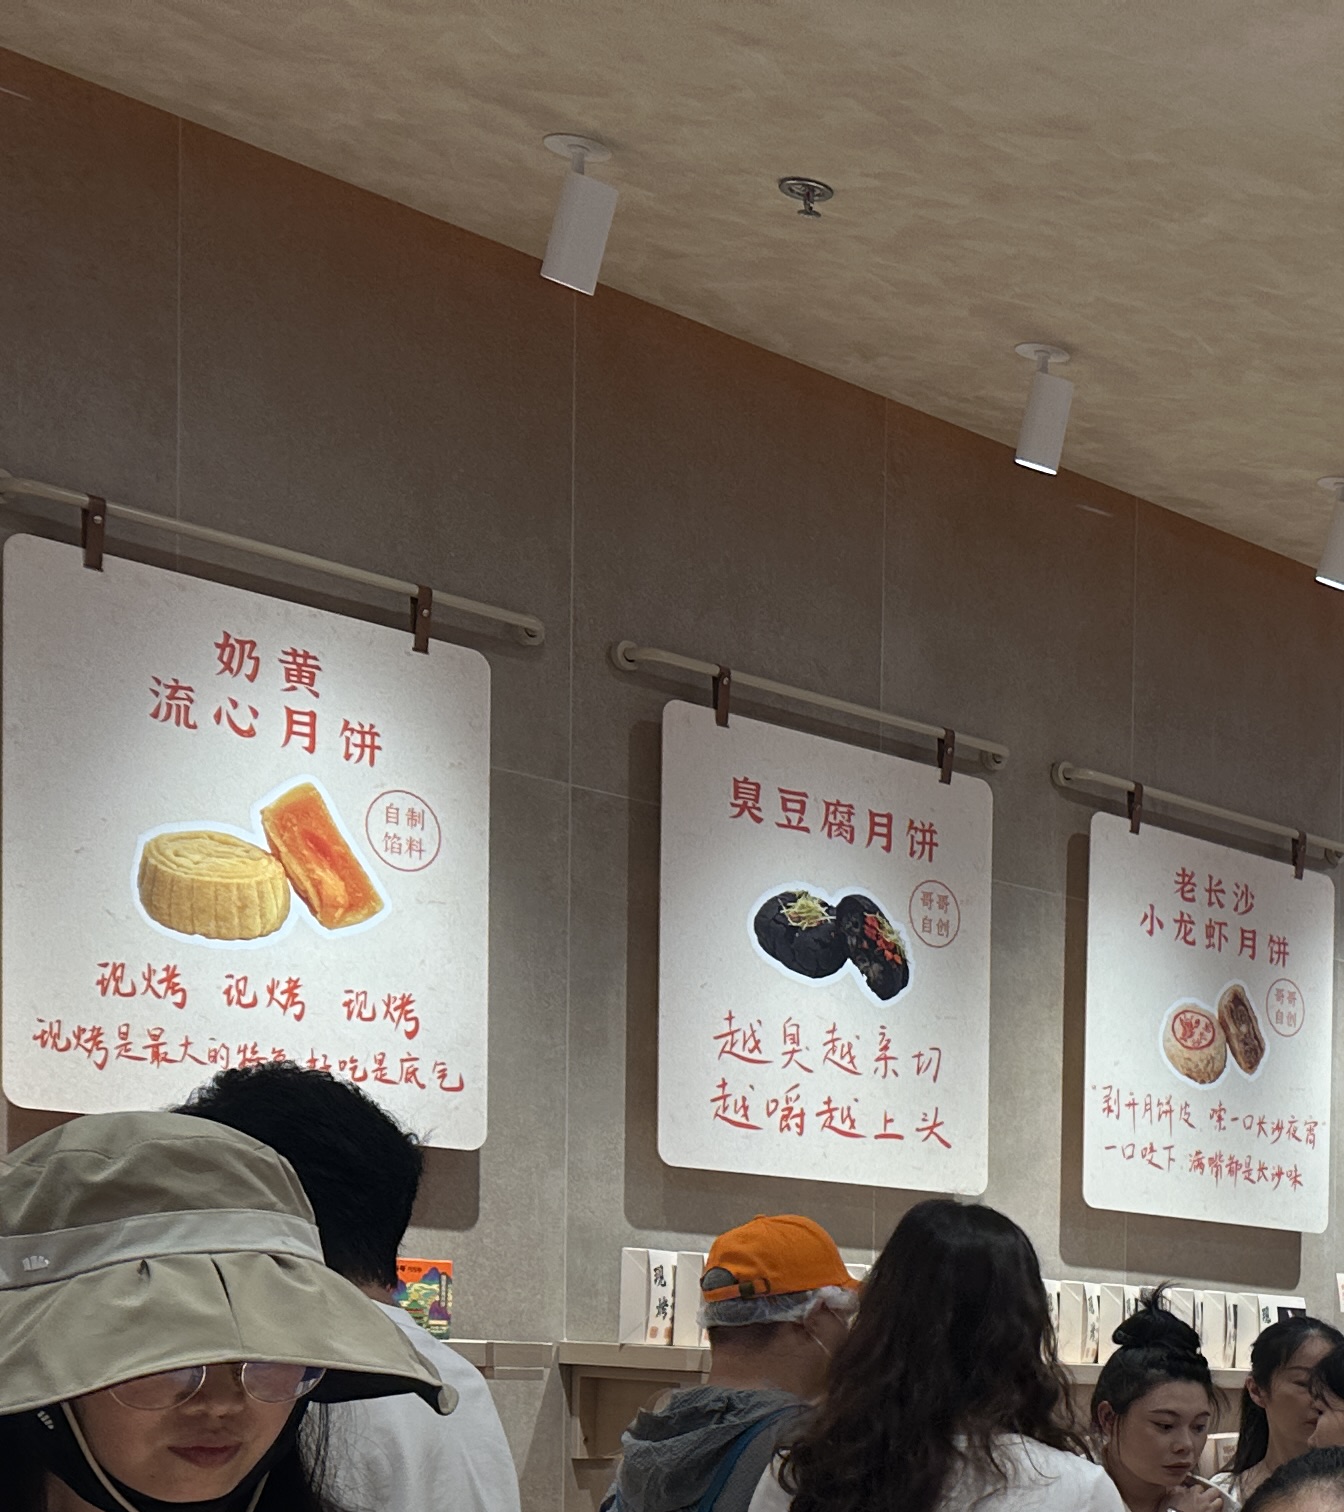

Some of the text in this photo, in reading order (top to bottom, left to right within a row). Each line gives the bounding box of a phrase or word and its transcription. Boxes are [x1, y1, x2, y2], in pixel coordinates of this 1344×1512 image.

[214, 631, 323, 698] 奶黄
[149, 676, 382, 768] 流心月饼
[382, 832, 426, 861] 馅料
[384, 803, 425, 831] 自制
[729, 776, 938, 863] 臭豆腐月饼
[1174, 866, 1255, 916] 老长沙
[1140, 903, 1290, 968] 小龙虾月饼
[96, 962, 420, 1040] 现烤 现烤 现烤
[713, 1009, 942, 1084] 越臭越亲切
[709, 1077, 952, 1148] 越嚼越上头
[1104, 1140, 1176, 1172] 一口咬下
